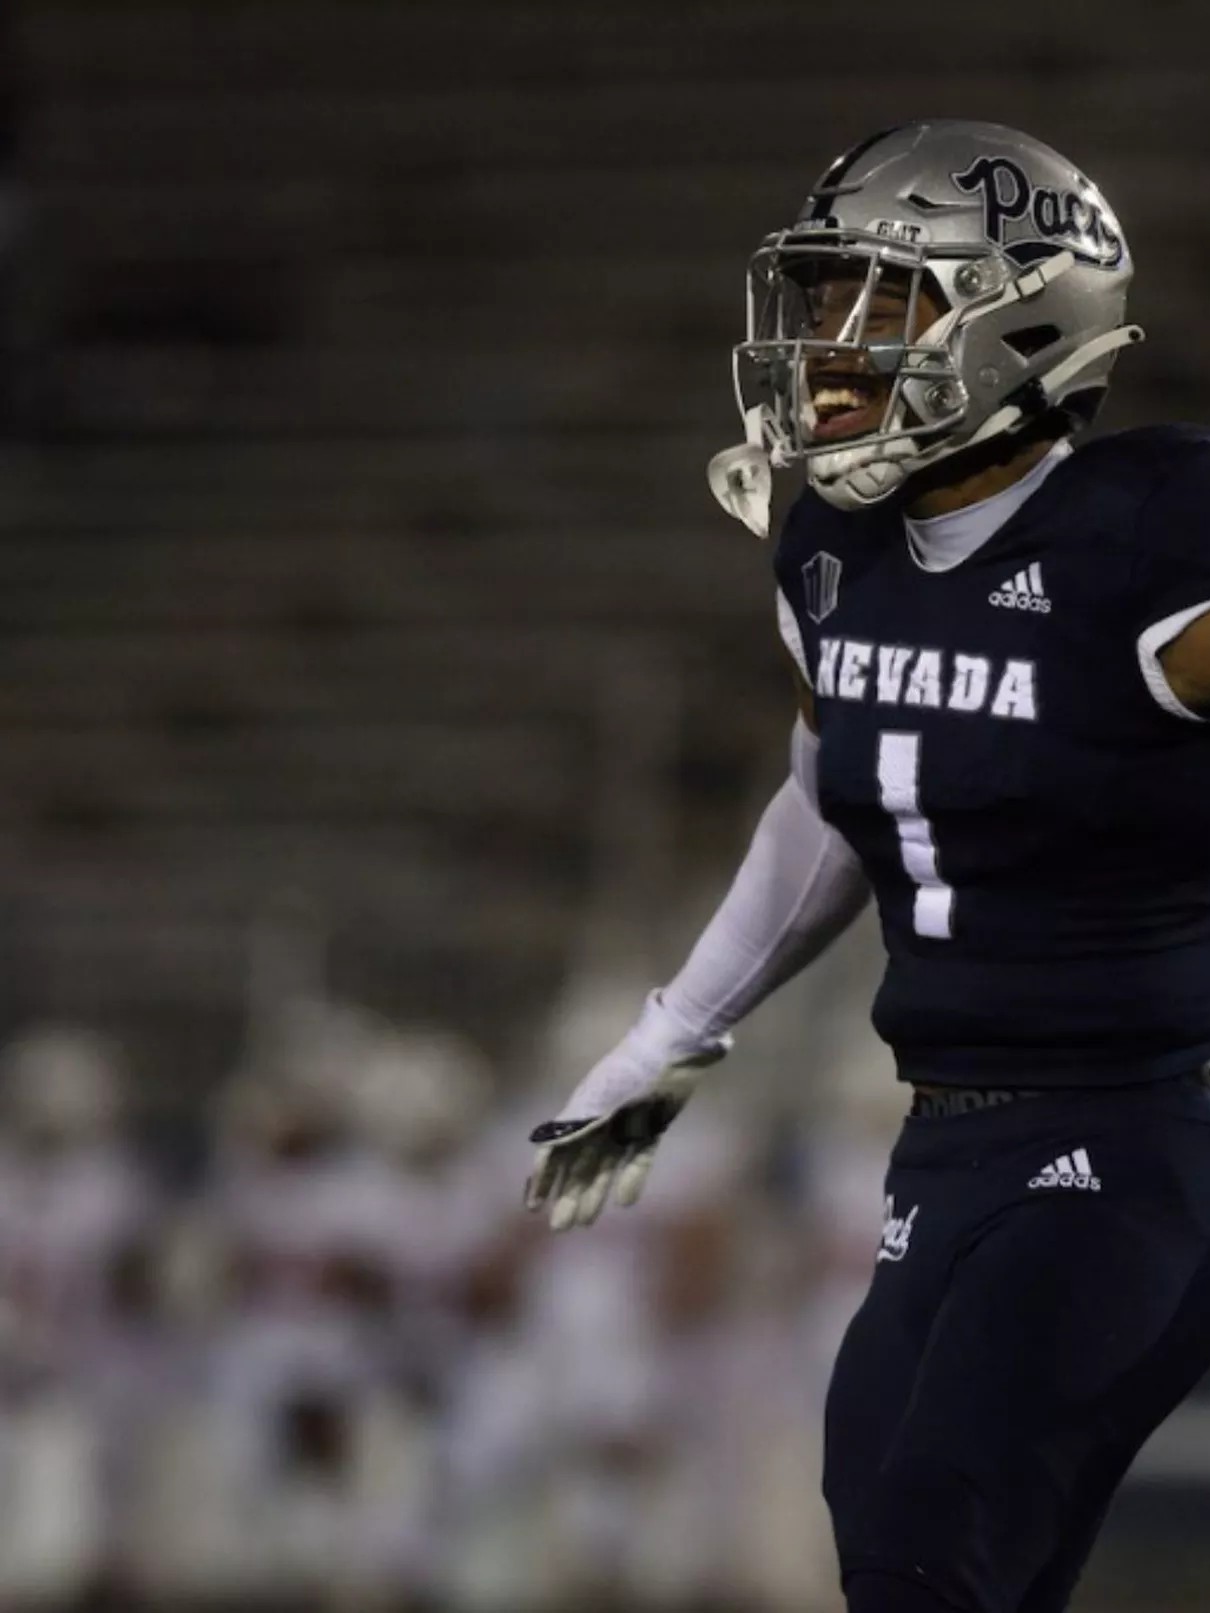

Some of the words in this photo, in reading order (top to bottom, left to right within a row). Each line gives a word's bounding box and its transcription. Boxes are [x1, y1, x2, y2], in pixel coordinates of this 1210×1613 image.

[988, 590, 1052, 614] adidas
[815, 636, 1039, 721] NEVADA
[876, 731, 954, 939] 1
[1027, 1172, 1102, 1192] adidas
